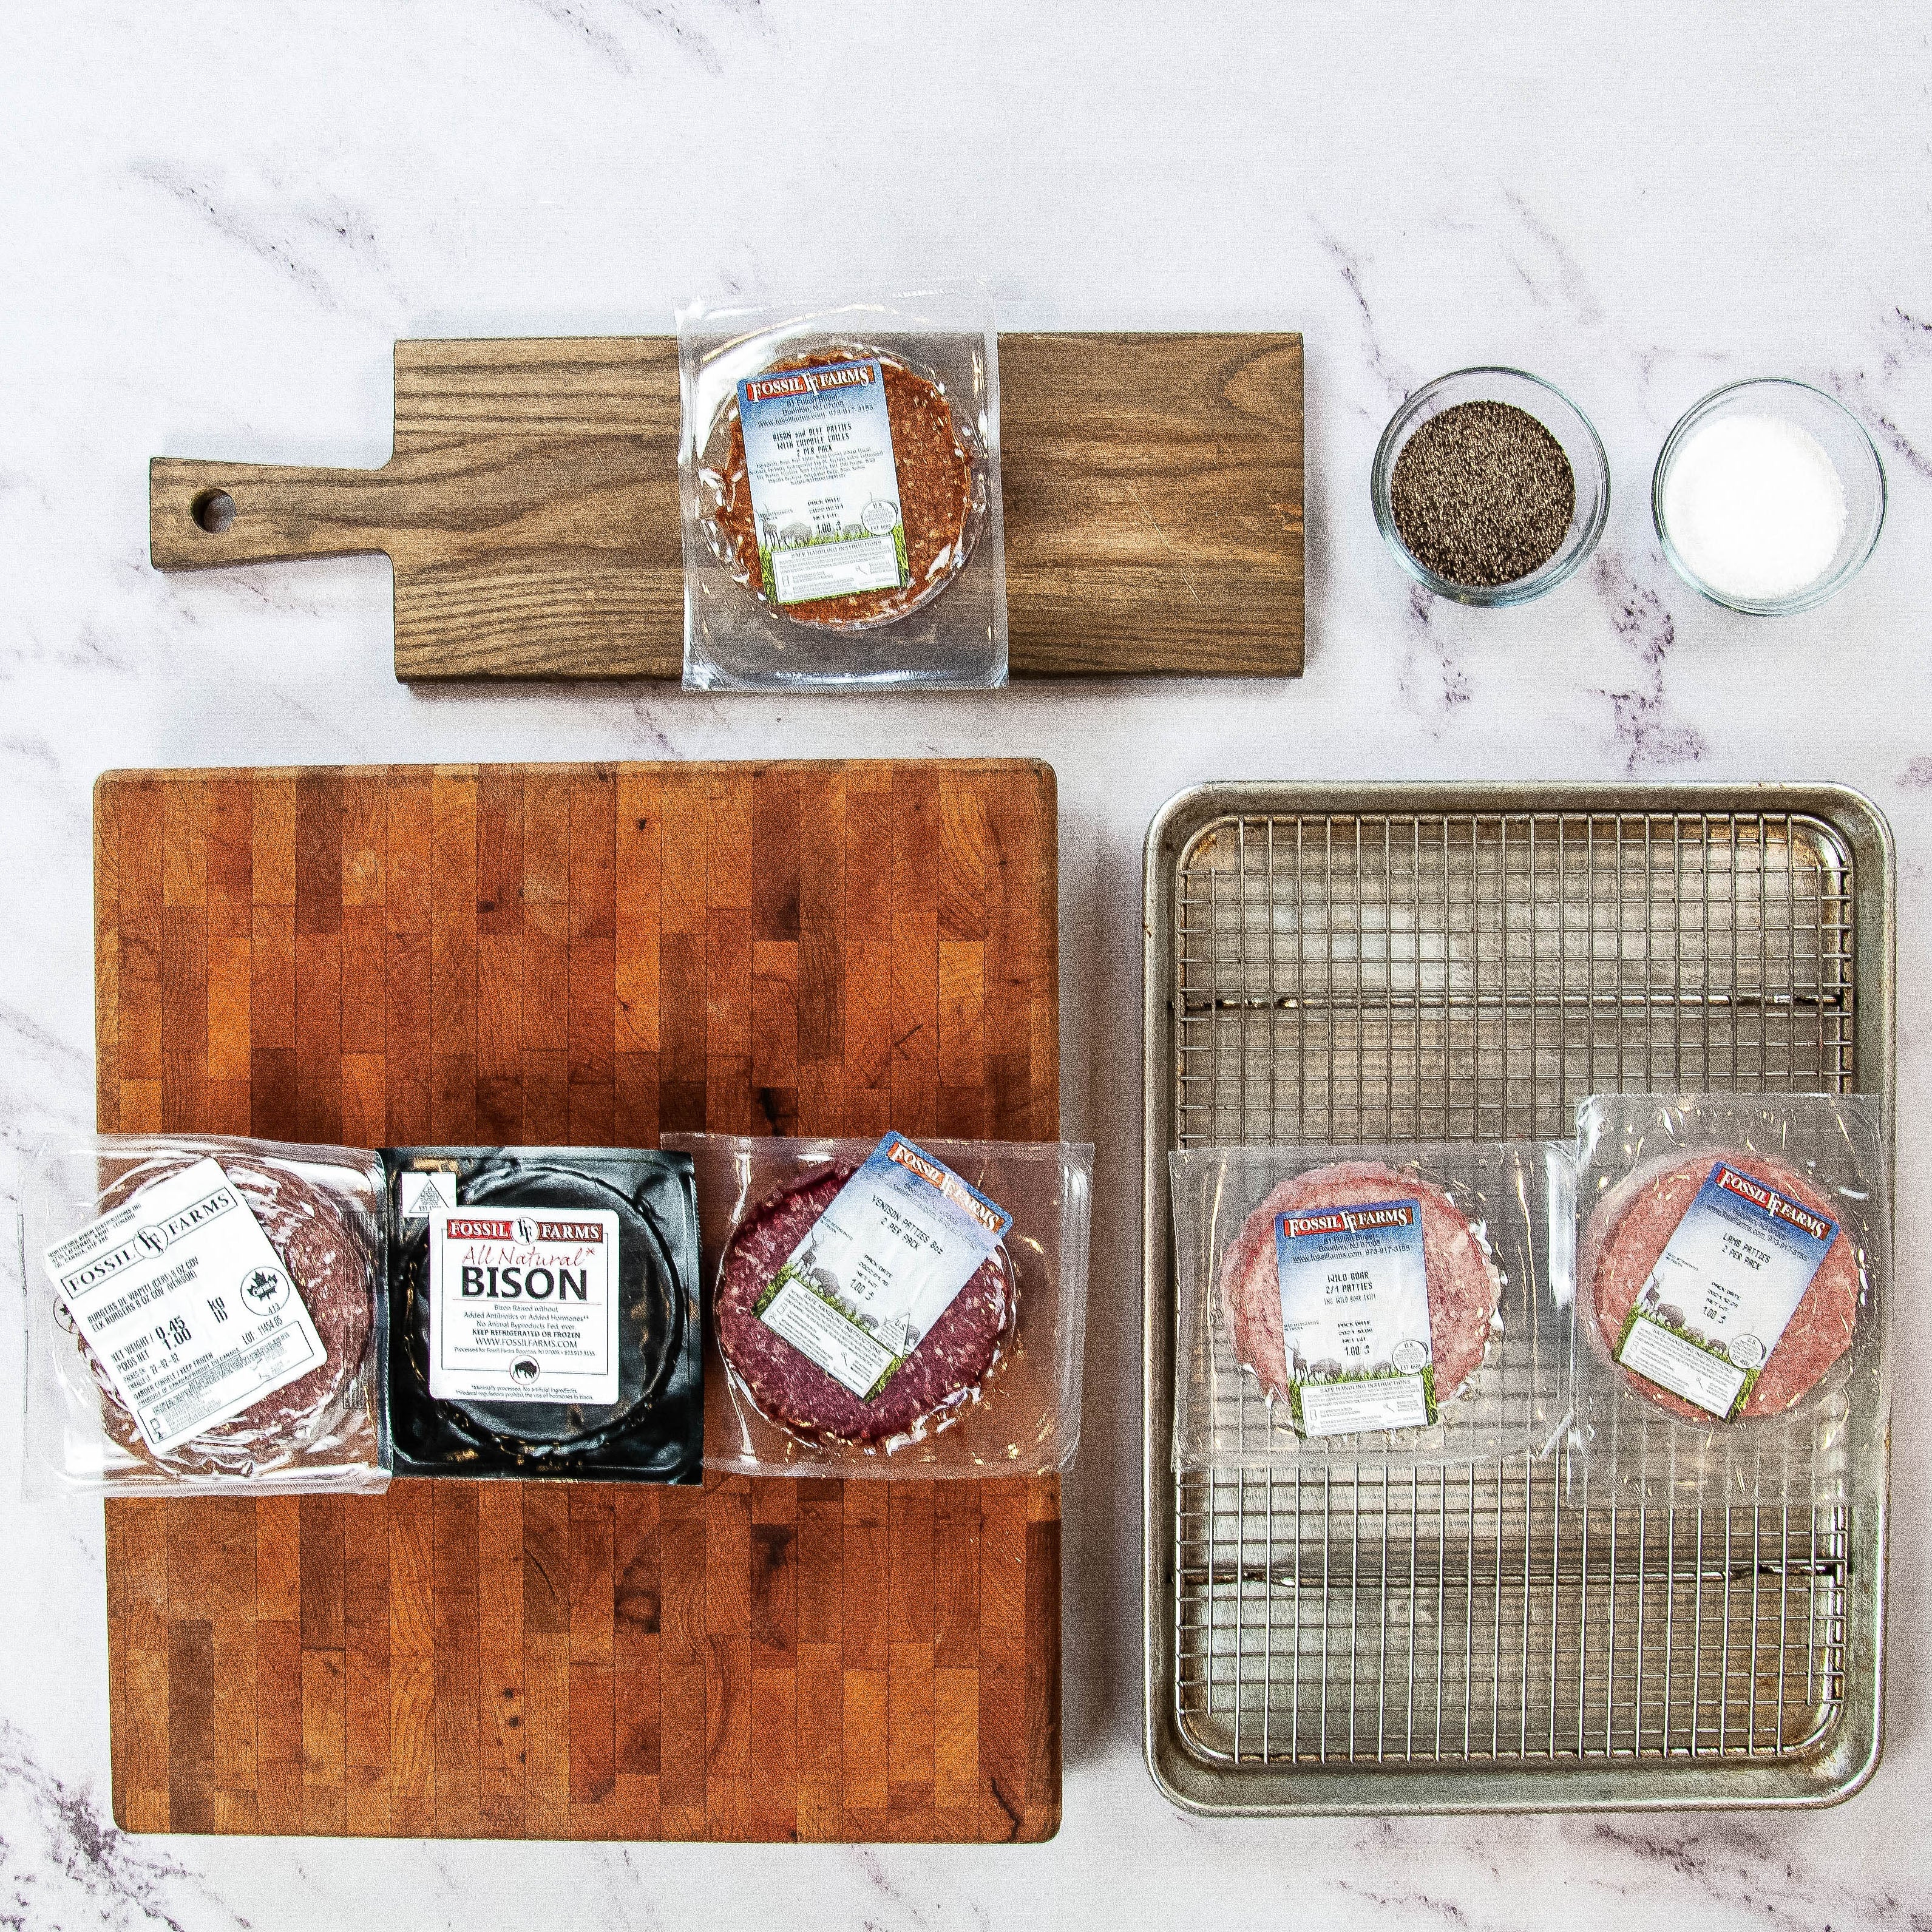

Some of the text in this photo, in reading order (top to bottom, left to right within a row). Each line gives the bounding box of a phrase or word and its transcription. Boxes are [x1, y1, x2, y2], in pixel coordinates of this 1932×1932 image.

[750, 375, 804, 403] FOSSIL
[819, 365, 870, 387] FARMS
[771, 431, 792, 442] BISON
[794, 429, 806, 438] and
[825, 422, 852, 434] PATTIES
[776, 440, 794, 450] WITH
[802, 446, 815, 455] PER
[816, 443, 833, 453] PACK
[888, 1143, 944, 1186] FOSSIL
[951, 1187, 1001, 1232] FARMS
[1717, 1169, 1771, 1203] FOSSIL
[1778, 1202, 1826, 1240] FARMS
[450, 1221, 509, 1237] FOSSIL
[541, 1223, 600, 1239] FARMS
[869, 1194, 946, 1255] VENISON PATTIES 8oz
[880, 1216, 922, 1251] 2 PER PACK
[1287, 1214, 1341, 1238] FOSSIL
[1357, 1207, 1408, 1227] FARMS
[68, 1246, 137, 1292] FOSSIL
[166, 1192, 231, 1236] FARMS
[1333, 1235, 1354, 1244] Fulton
[462, 1243, 495, 1266] All
[1721, 1244, 1763, 1272] 2 PER PACK
[1741, 1243, 1772, 1264] PATTIES
[863, 1253, 893, 1280] PACK DATE
[1327, 1271, 1369, 1283] WILD BOAR
[86, 1301, 119, 1325] BURGERS
[117, 1295, 129, 1307] DE
[127, 1282, 152, 1302] WAPITI
[175, 1263, 187, 1275] OZ
[184, 1255, 200, 1270] COV
[461, 1265, 588, 1301] BISON
[847, 1277, 867, 1295] 1.00
[1325, 1281, 1373, 1294] 2/1 PATTIES
[1710, 1281, 1742, 1301] PACK DATE
[90, 1319, 106, 1333] ELK
[104, 1302, 136, 1326] BURGERS
[140, 1293, 152, 1306] OZ
[149, 1286, 166, 1300] COV
[1700, 1304, 1718, 1320] 1.00
[109, 1348, 126, 1364] NET
[123, 1334, 151, 1357] WEIGHT
[154, 1313, 187, 1341] 0.45
[205, 1293, 226, 1314] kg
[490, 1329, 540, 1337] REFRIGERATED
[802, 1292, 818, 1306] SAFE
[816, 1303, 846, 1327] HANDLING
[842, 1324, 883, 1355] INSTRUCTIONS
[893, 1318, 909, 1332] U.S.
[115, 1306, 229, 1375] POIDS NET 1.00 lb
[240, 1329, 258, 1345] LOT:
[475, 1337, 577, 1348] WWW.FOSSILFARMS.COM
[1344, 1345, 1360, 1357] 1.00
[178, 1362, 194, 1375] KEEP
[192, 1351, 214, 1368] FROZEN
[1335, 1383, 1366, 1392] HANDLING
[1367, 1379, 1411, 1389] INSTRUCTIONS
